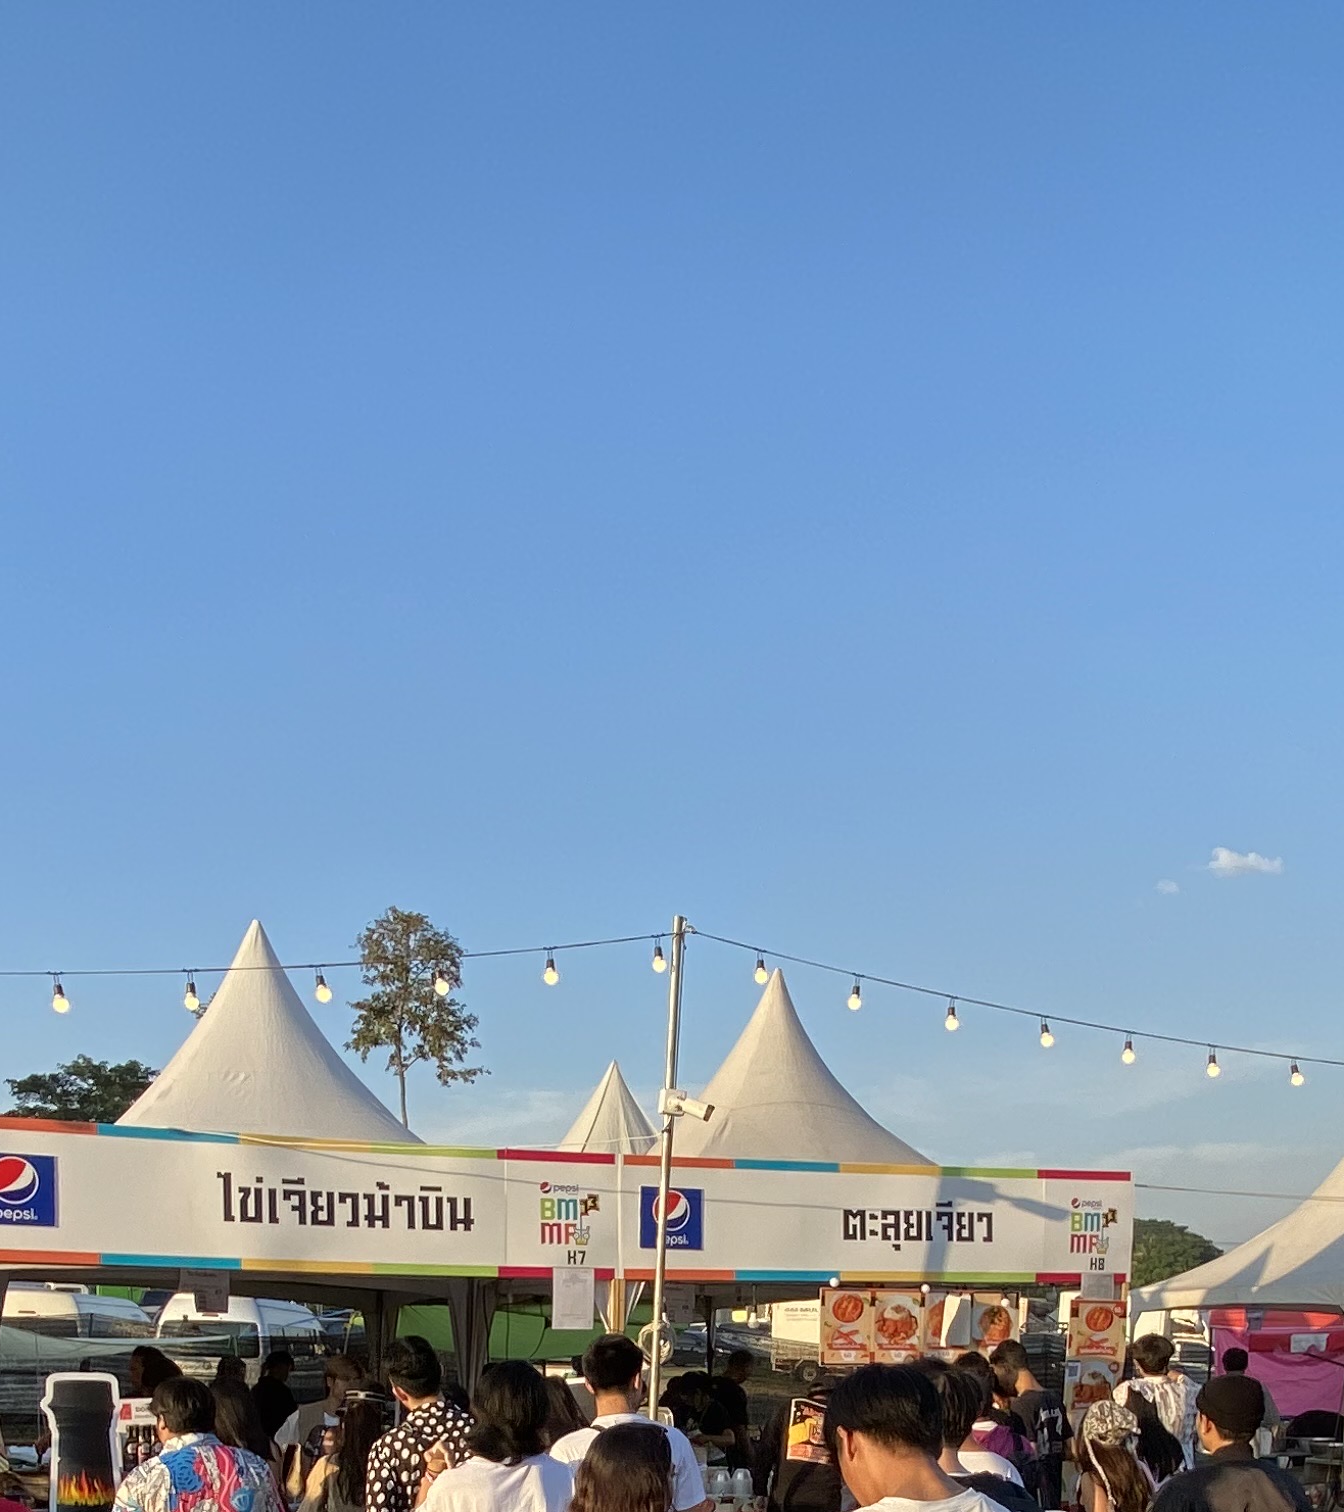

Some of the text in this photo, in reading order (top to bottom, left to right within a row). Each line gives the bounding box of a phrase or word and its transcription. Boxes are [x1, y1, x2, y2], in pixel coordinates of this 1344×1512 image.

[217, 1171, 475, 1231] ไข่เจียวม้าบิน
[553, 1184, 579, 1194] pepsi
[665, 1233, 687, 1246] epsi
[843, 1201, 993, 1251] ตะลุยเจียว
